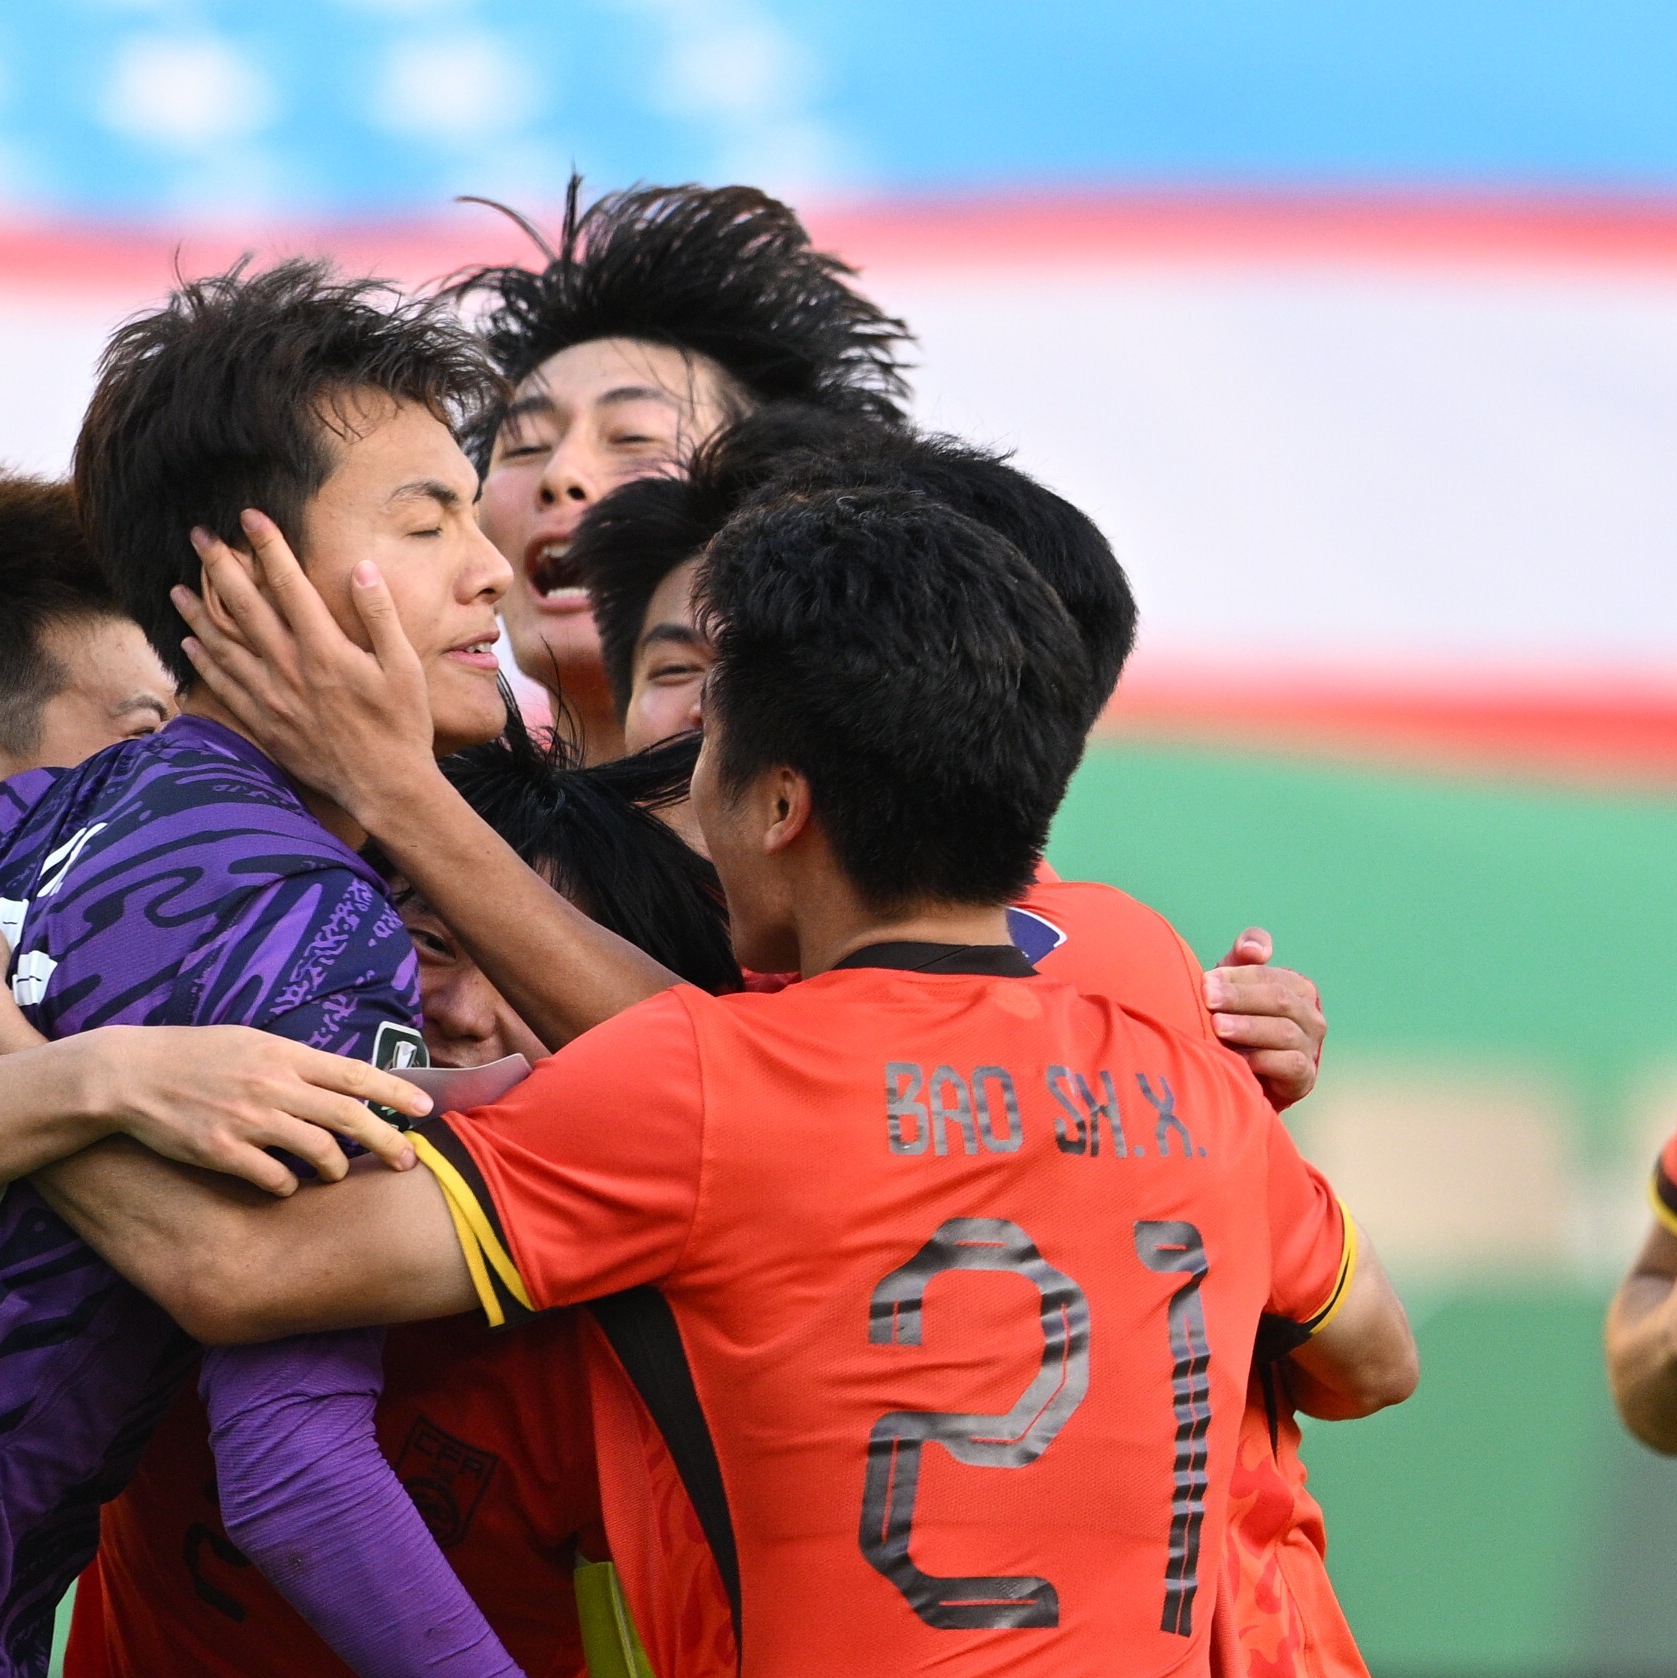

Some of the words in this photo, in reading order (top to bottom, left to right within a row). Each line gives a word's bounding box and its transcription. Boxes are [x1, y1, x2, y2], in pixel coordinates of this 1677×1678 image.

[884, 1061, 1024, 1156] BAO
[1046, 1065, 1208, 1158] SH.X.
[858, 1217, 1209, 1639] 21
